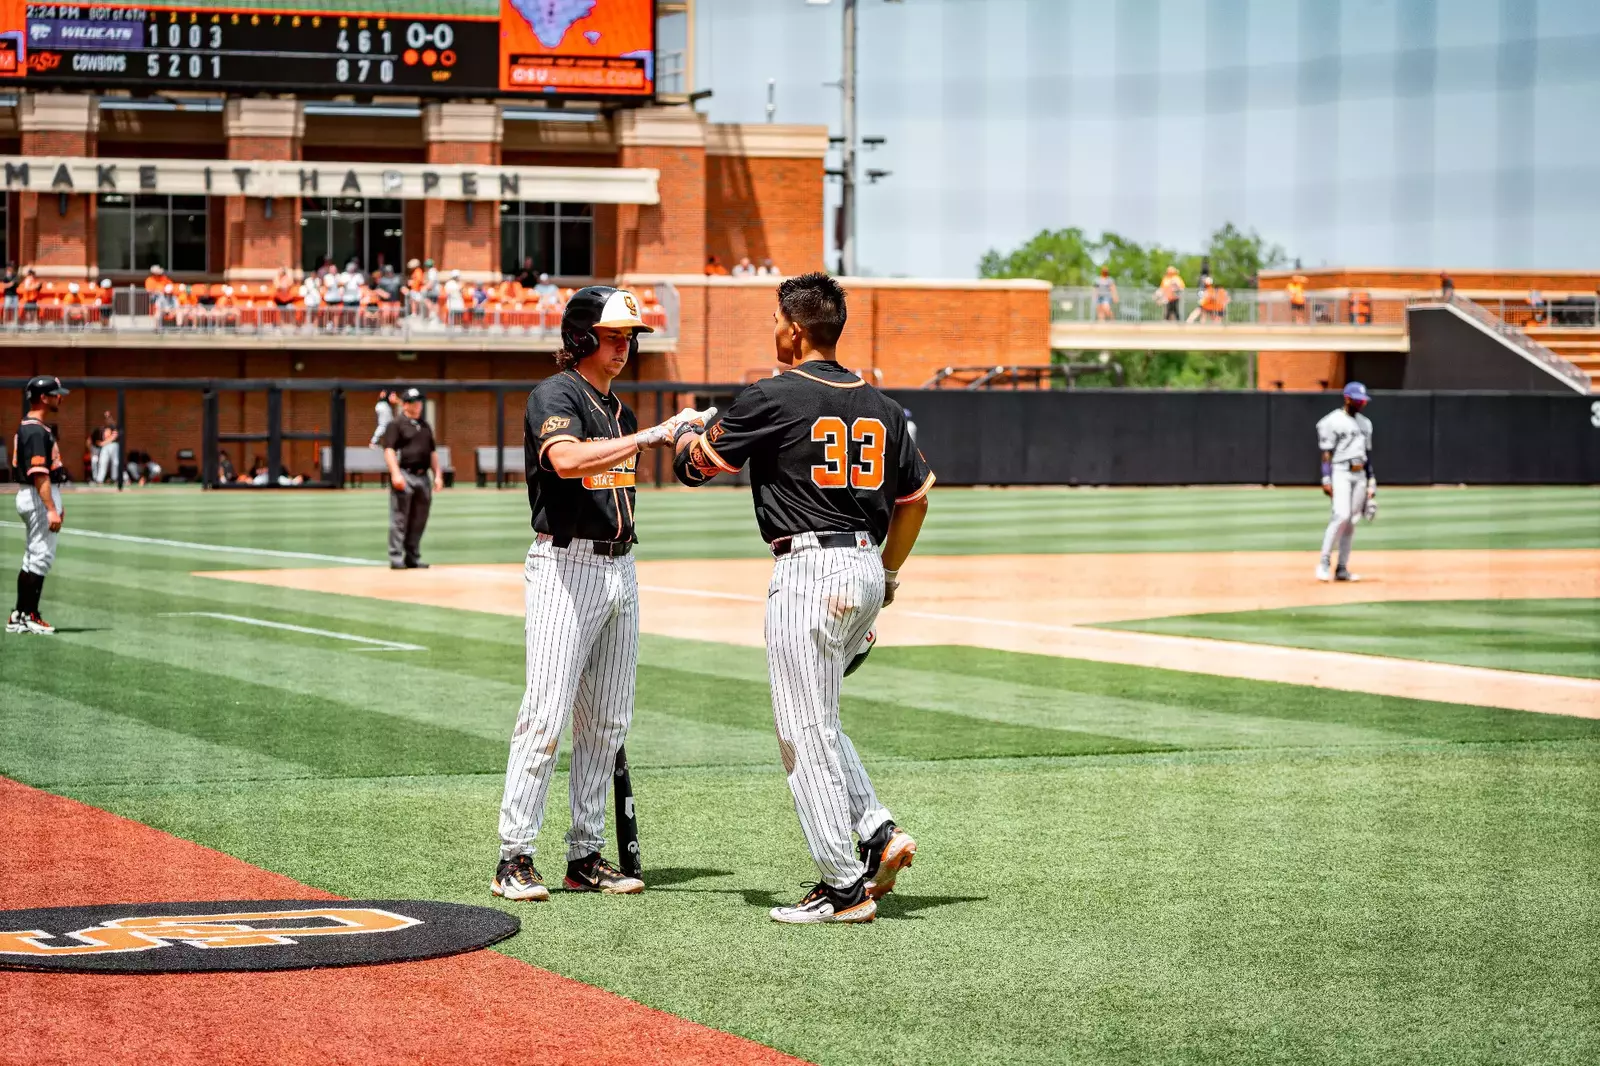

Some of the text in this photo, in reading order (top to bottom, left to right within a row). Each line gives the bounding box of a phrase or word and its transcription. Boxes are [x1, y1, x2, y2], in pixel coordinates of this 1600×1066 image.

[27, 5, 80, 20] 2:24 PM
[61, 27, 133, 41] WILDCATS
[149, 24, 392, 53] 1 0 0 3 4 6 1
[72, 53, 126, 72] COWBOYS
[148, 54, 393, 83] 5 2 0 1 8 7 0
[5, 162, 520, 196] MAKE IT HAPPEN
[811, 416, 887, 490] 33
